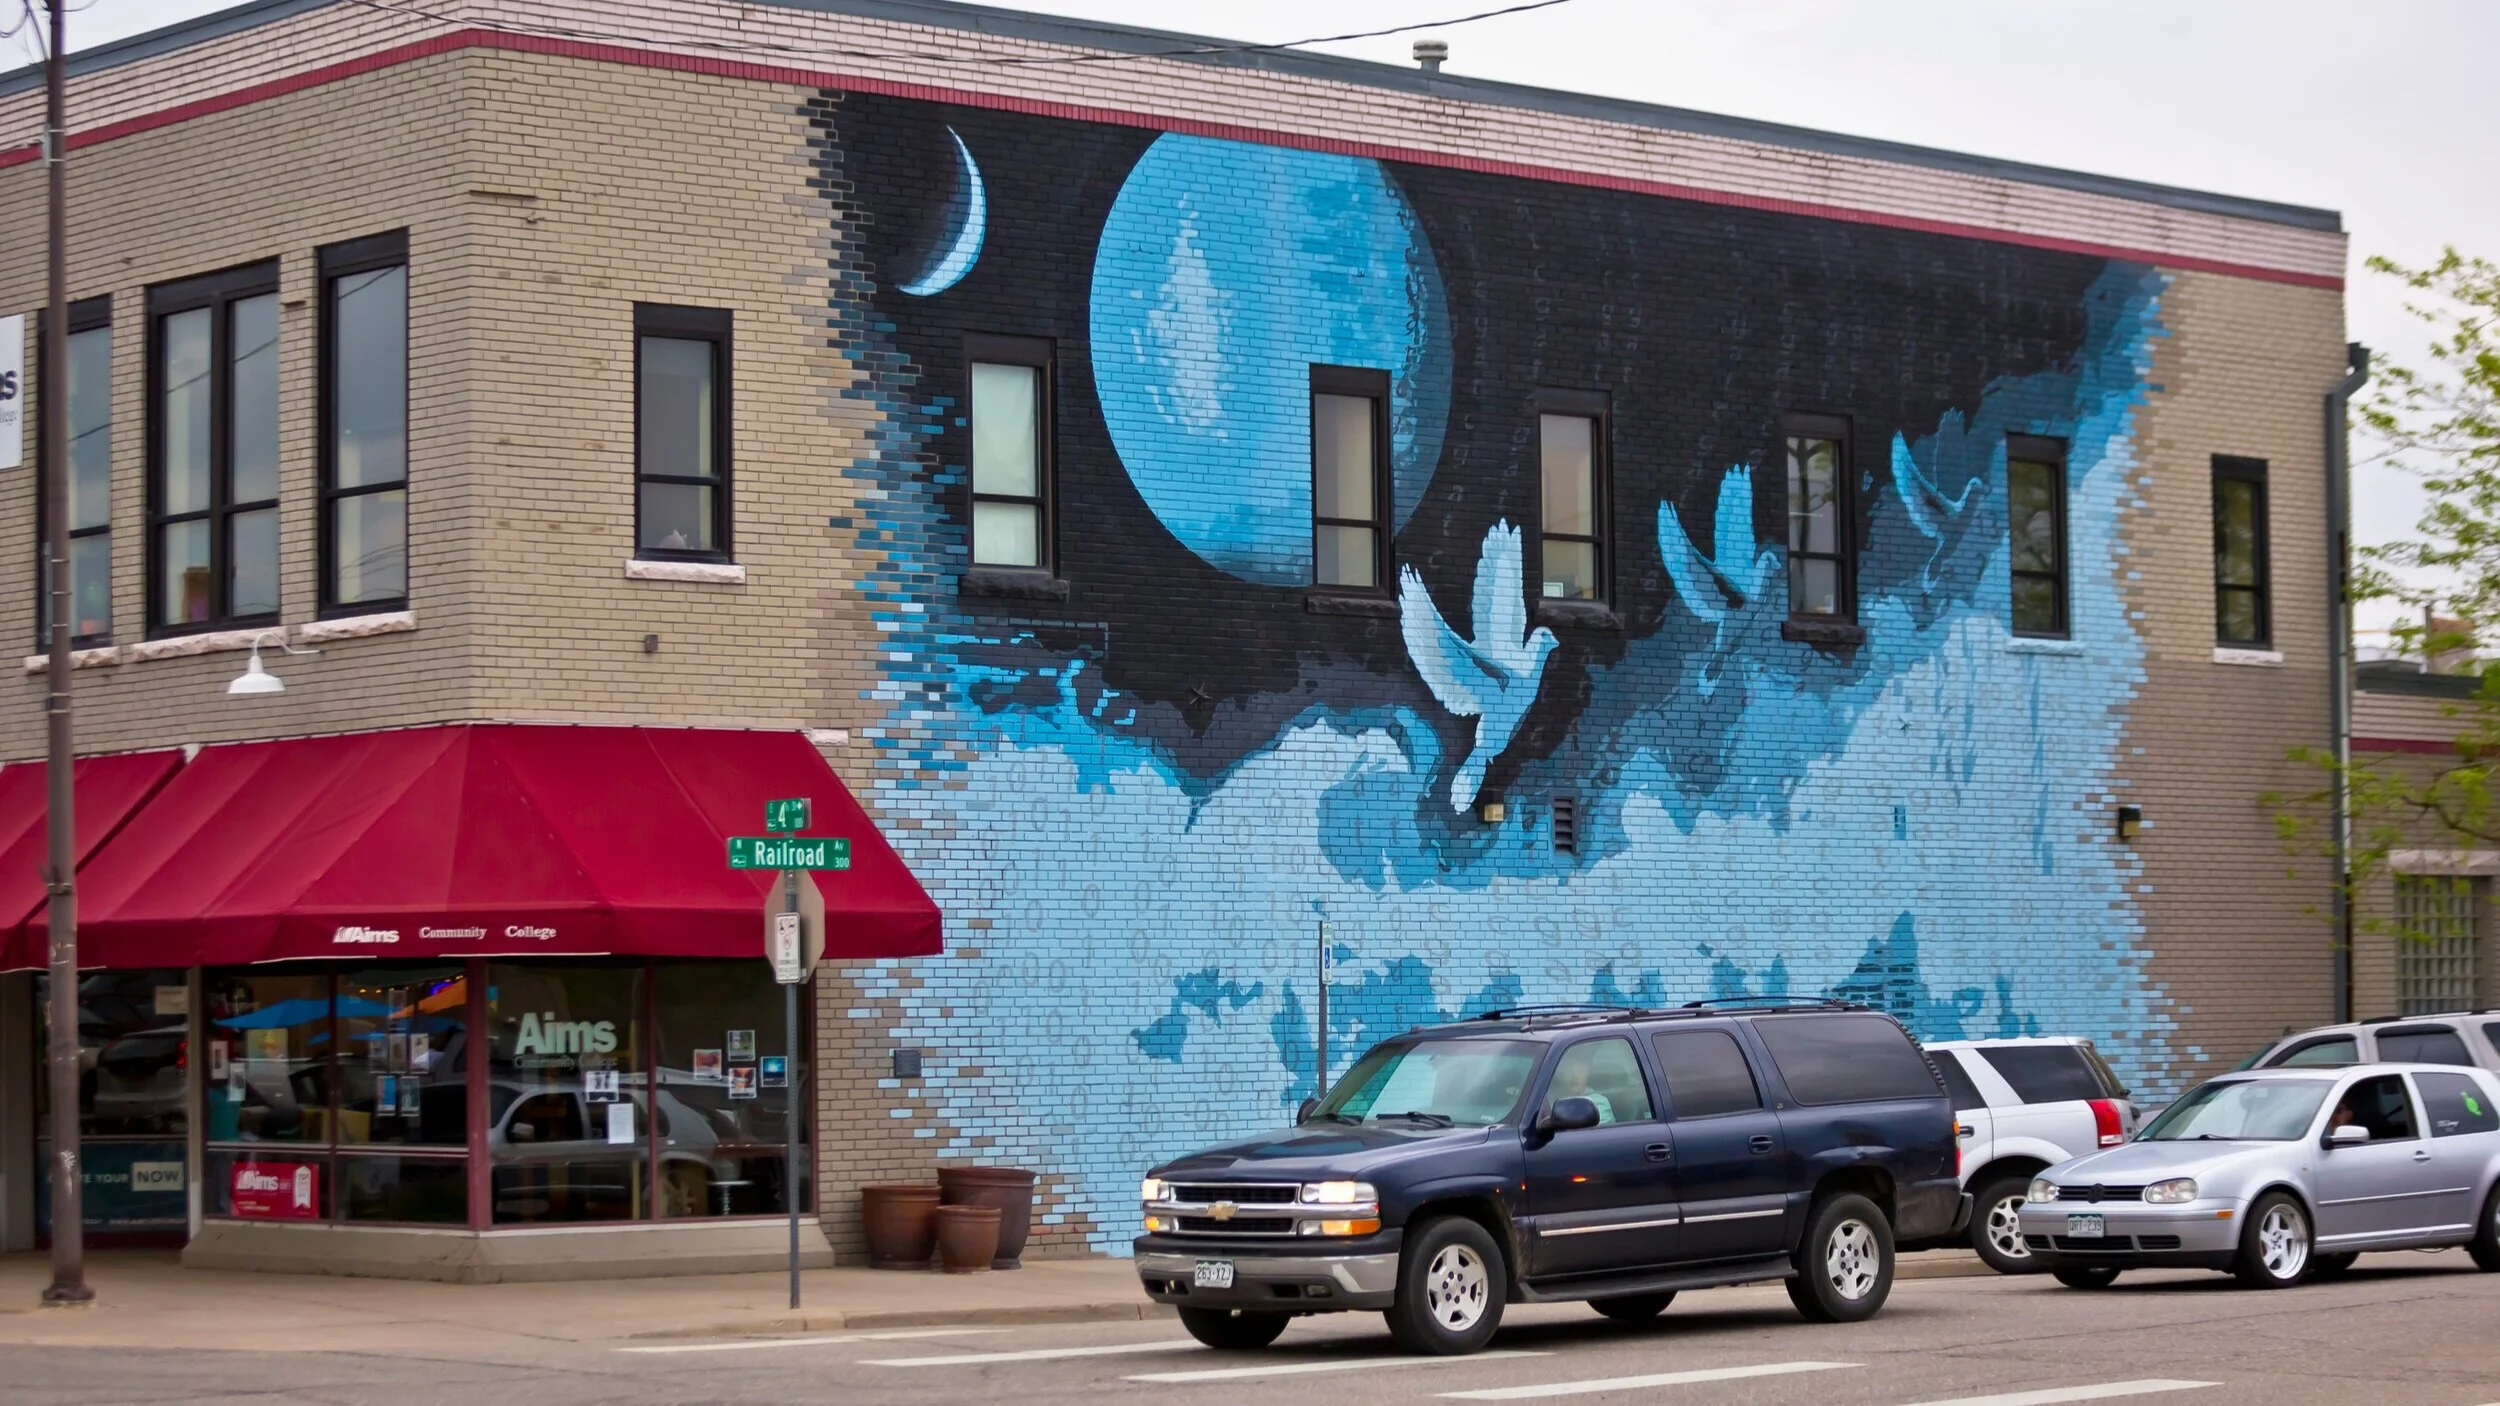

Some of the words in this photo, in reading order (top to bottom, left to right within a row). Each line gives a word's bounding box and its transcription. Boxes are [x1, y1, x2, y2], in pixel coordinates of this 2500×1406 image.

[755, 840, 825, 866] Railroad
[834, 840, 844, 851] Av
[834, 857, 850, 868] 300
[346, 926, 400, 943] Aims
[419, 926, 487, 940] Community
[505, 925, 557, 940] College
[514, 1011, 618, 1055] Aims
[137, 1170, 179, 1184] NOW
